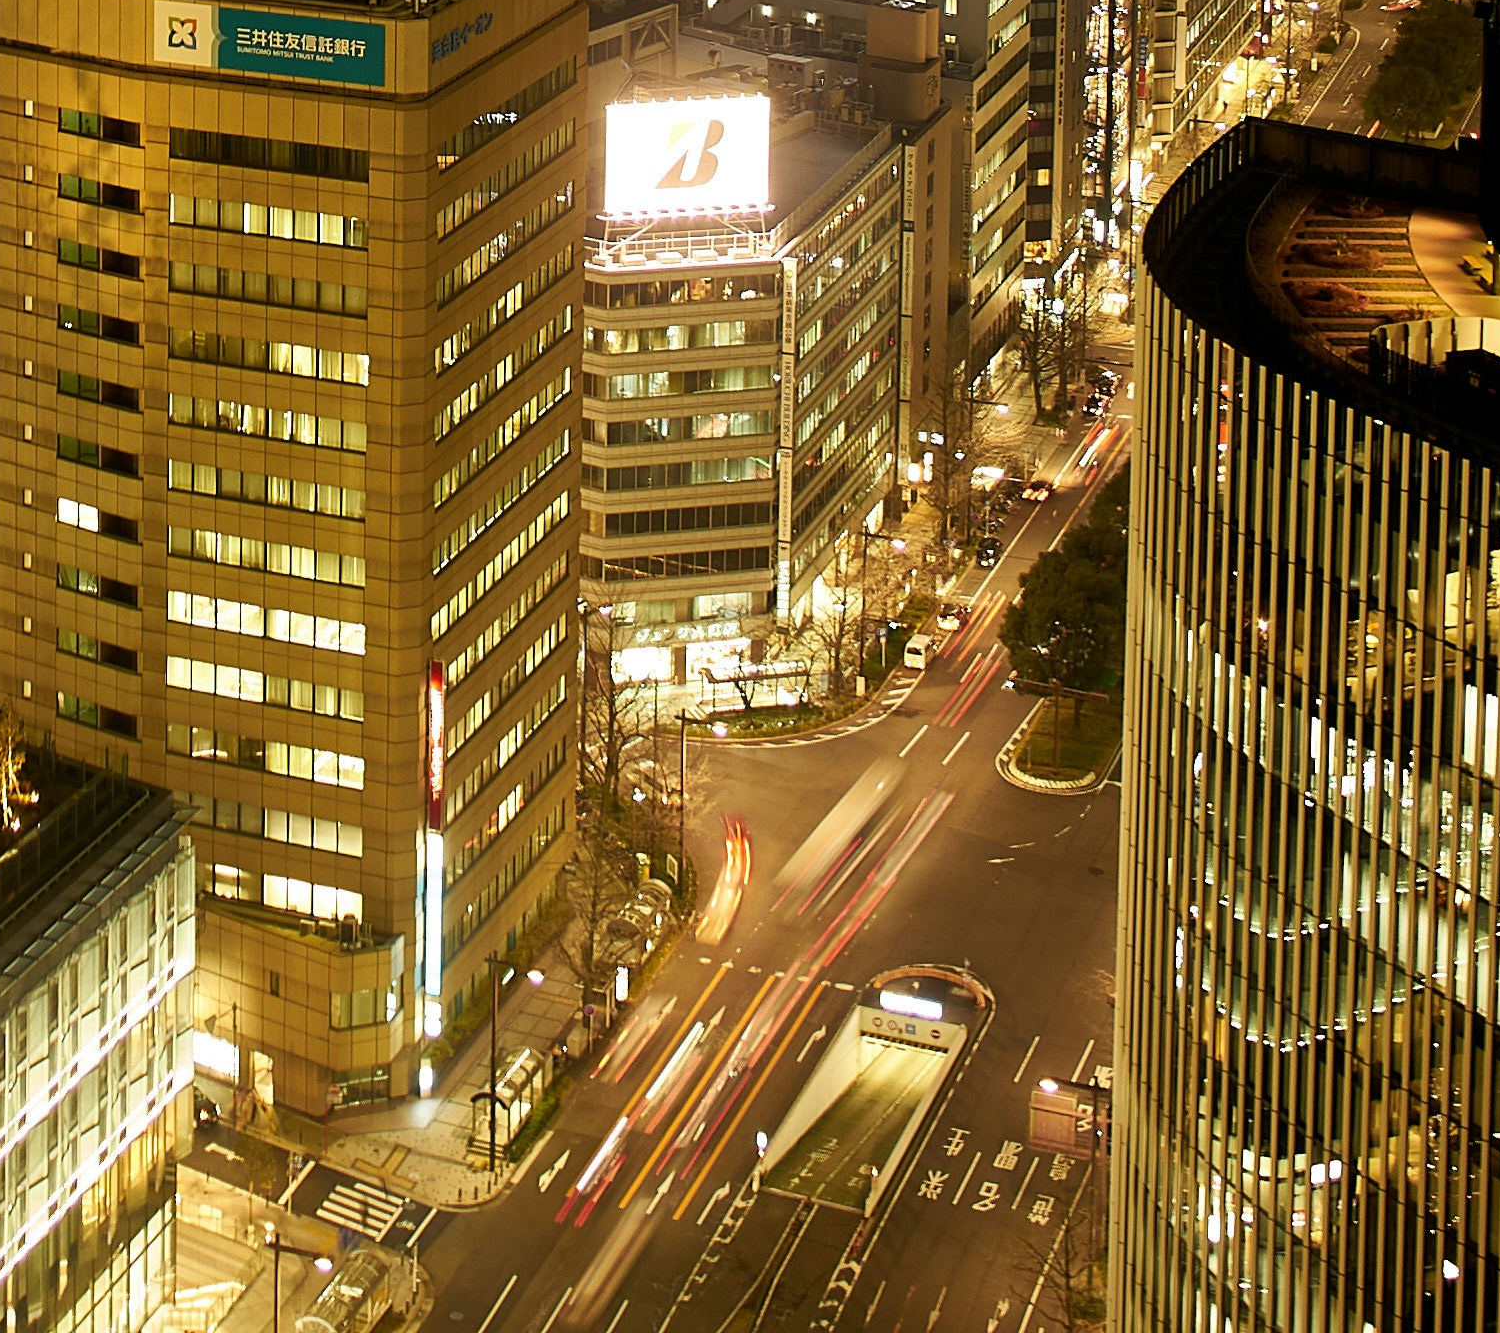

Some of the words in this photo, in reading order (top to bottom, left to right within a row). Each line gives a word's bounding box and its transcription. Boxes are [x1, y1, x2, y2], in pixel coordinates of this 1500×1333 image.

[236, 27, 367, 59] 三井住友信託銀行
[236, 45, 271, 57] SUMITOMO
[272, 49, 294, 59] MITSUI
[295, 52, 315, 61] TRUST
[315, 54, 334, 63] BANK
